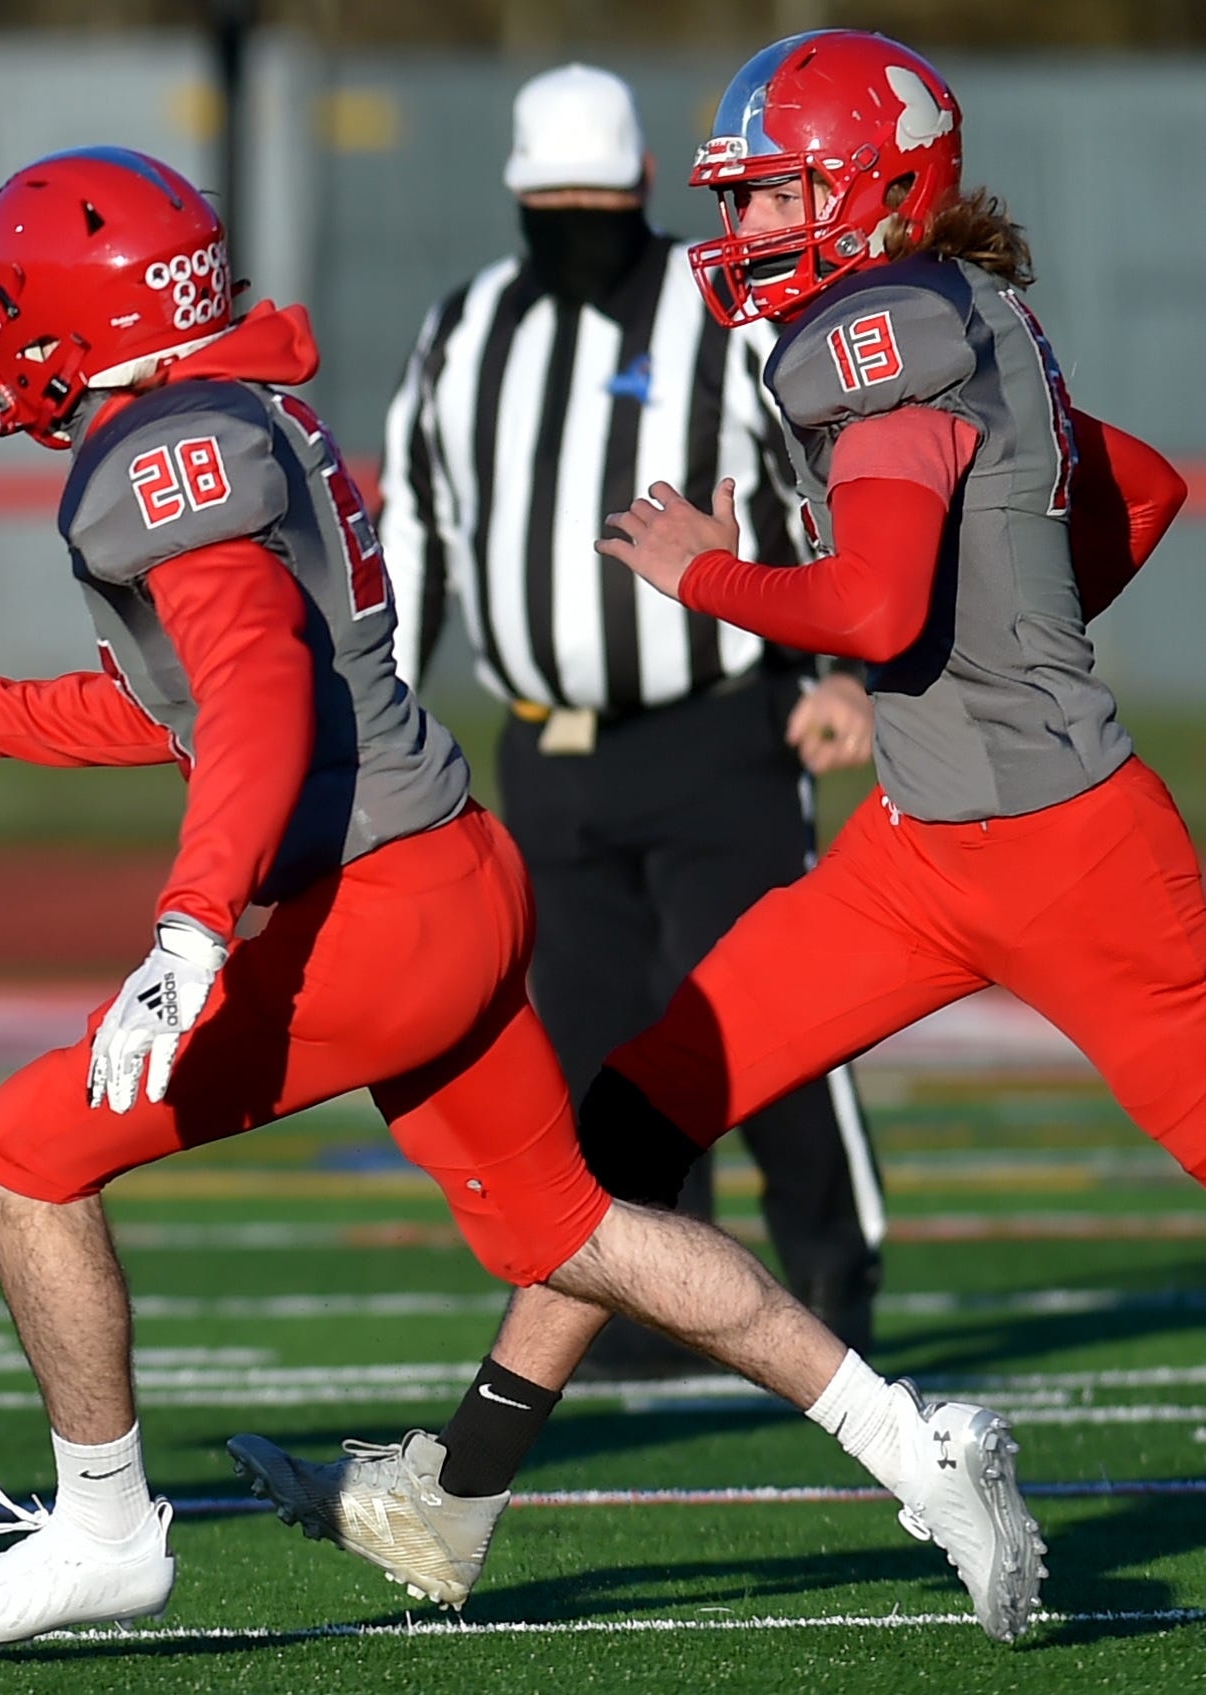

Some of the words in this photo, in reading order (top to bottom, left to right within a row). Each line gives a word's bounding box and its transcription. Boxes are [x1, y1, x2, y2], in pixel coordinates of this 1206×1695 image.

[826, 310, 904, 393] 13
[128, 435, 232, 530] 28
[163, 971, 179, 1027] adidas
